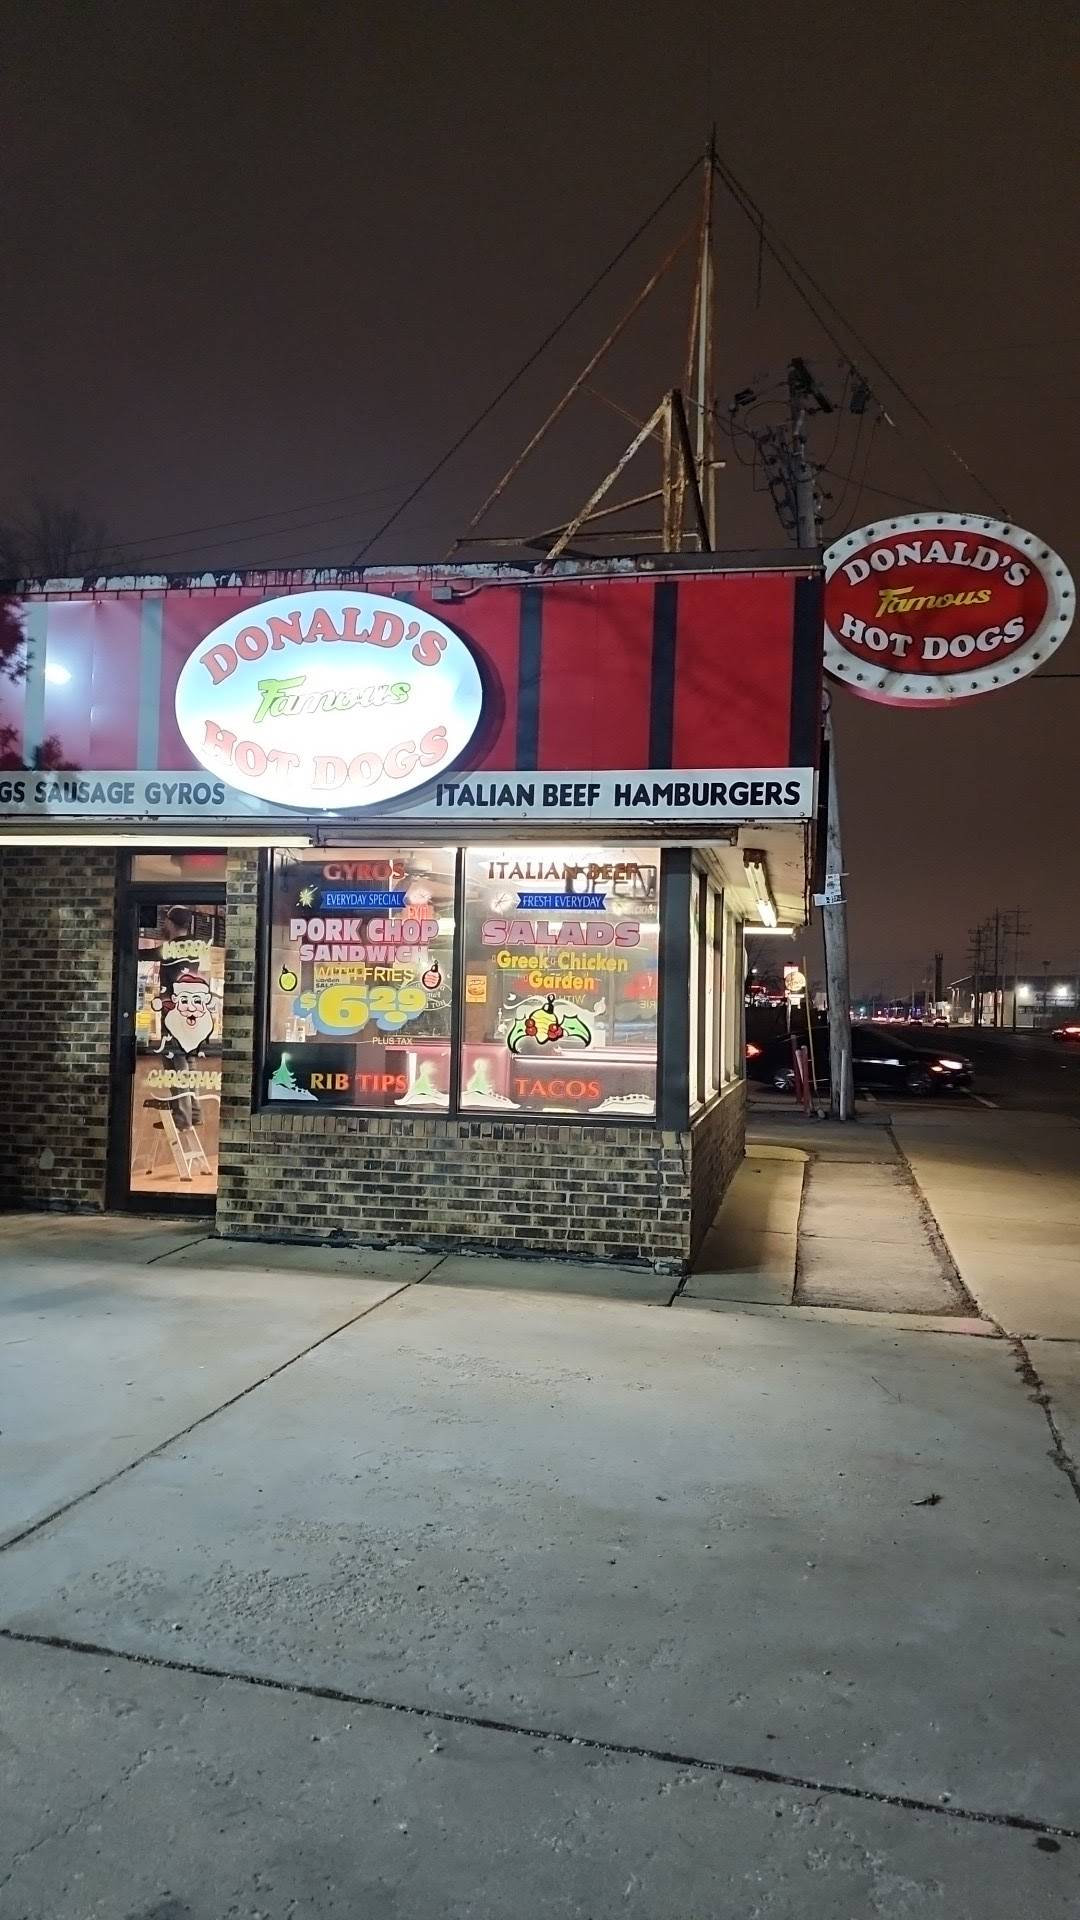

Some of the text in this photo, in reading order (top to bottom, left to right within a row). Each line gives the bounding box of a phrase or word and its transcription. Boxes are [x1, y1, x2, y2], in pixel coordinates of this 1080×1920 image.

[842, 540, 1031, 586] DONALD'S
[875, 586, 992, 618] Famous
[200, 607, 447, 685] DONALD'S
[839, 613, 1025, 660] HOT DOGS
[253, 675, 411, 723] Famous
[202, 720, 449, 790] HOT DOGS
[34, 781, 136, 804] SAUSAGE
[144, 782, 225, 805] GYROS
[435, 781, 801, 807] ITALIAN BEEF HAMBURGERS
[322, 863, 406, 880] GYROS
[488, 862, 638, 880] ITALIAN BEEF
[326, 894, 401, 906] EVERYDAY SPECIAL
[522, 895, 602, 909] FRESH EVERYDAY
[289, 918, 439, 945] PORK CHOP
[481, 920, 641, 947] SALADS
[300, 945, 429, 963] SANDWICH
[497, 950, 628, 972] Greek Chicken
[364, 968, 416, 982] FRIES
[528, 970, 595, 990] Garden
[372, 1037, 413, 1045] PLUS TAX
[310, 1073, 407, 1093] RIB TIPS
[515, 1079, 600, 1098] TACOS
